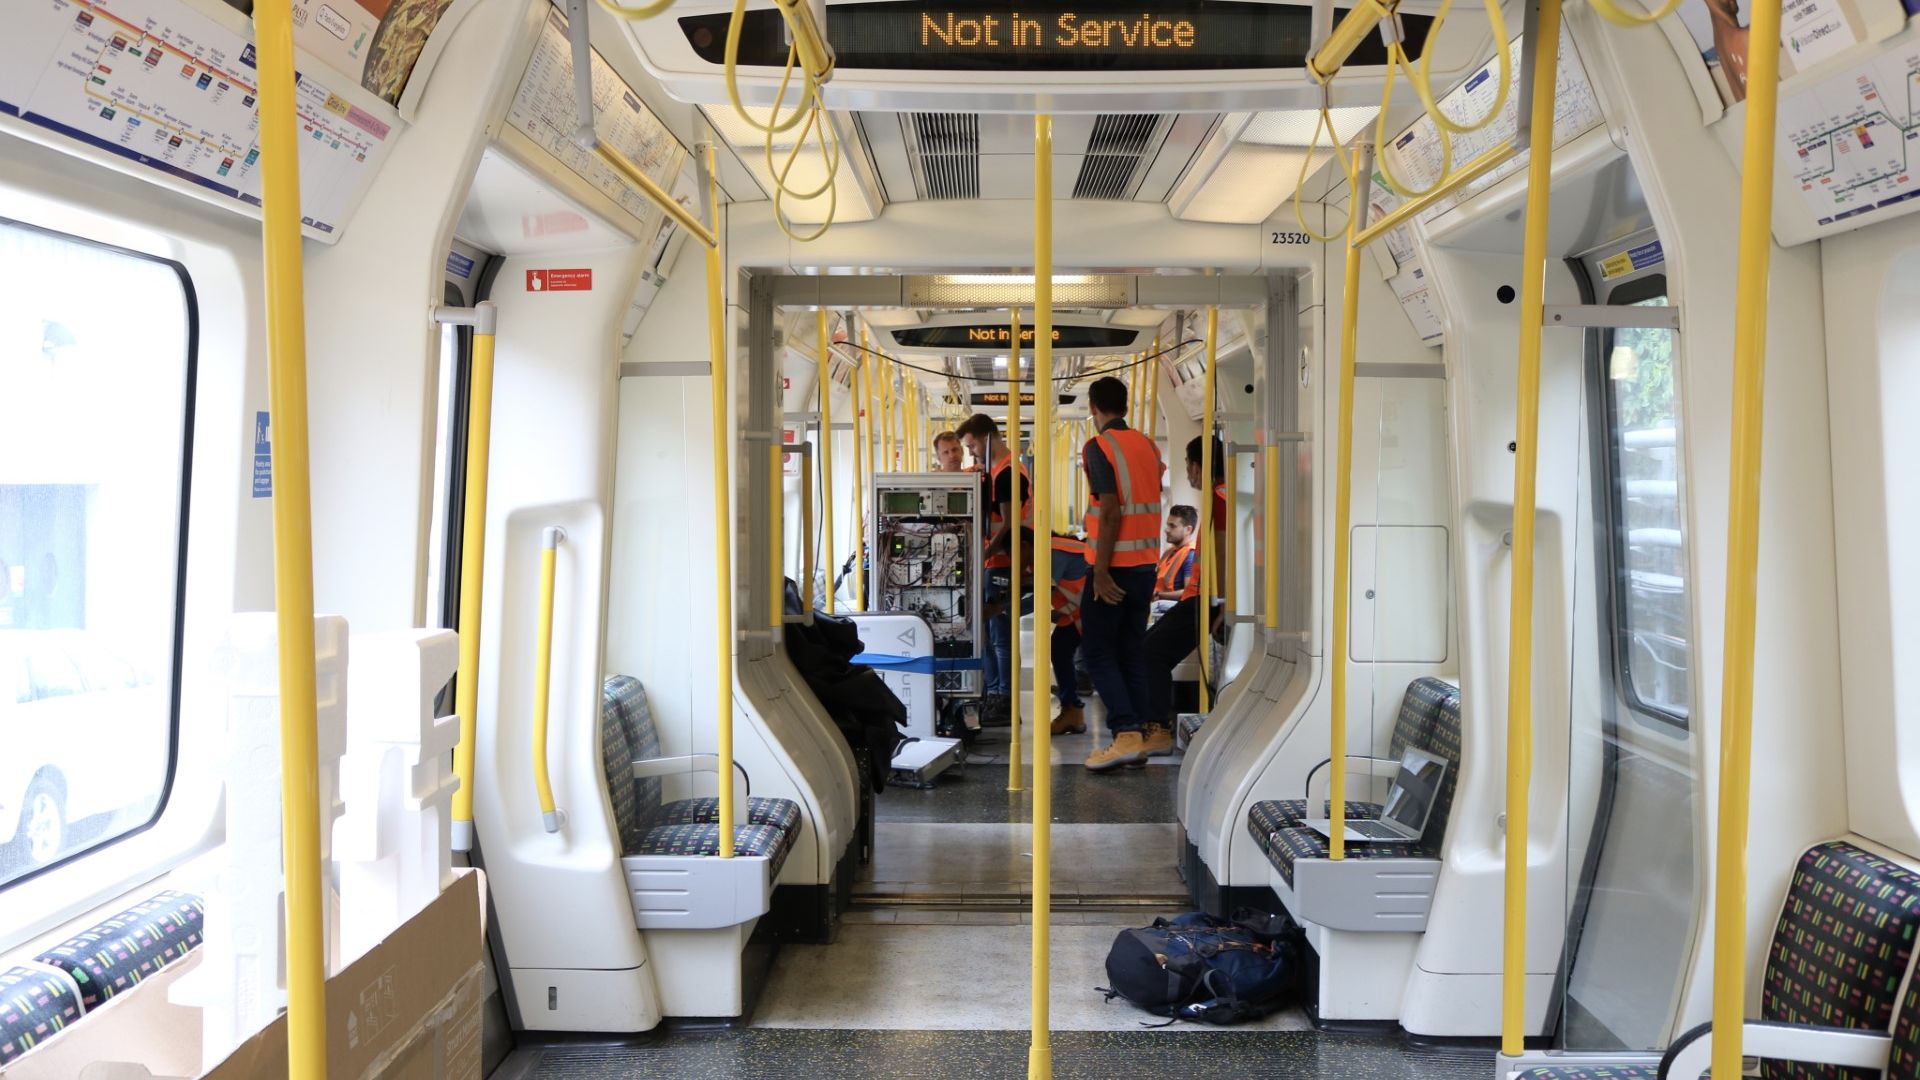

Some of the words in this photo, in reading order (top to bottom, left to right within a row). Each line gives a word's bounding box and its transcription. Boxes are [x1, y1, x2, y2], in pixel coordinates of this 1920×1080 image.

[921, 12, 999, 46] Not
[1012, 12, 1041, 46] in
[1055, 12, 1195, 47] Service
[1271, 232, 1311, 244] 23520
[969, 328, 995, 340] Not
[998, 328, 1010, 340] in
